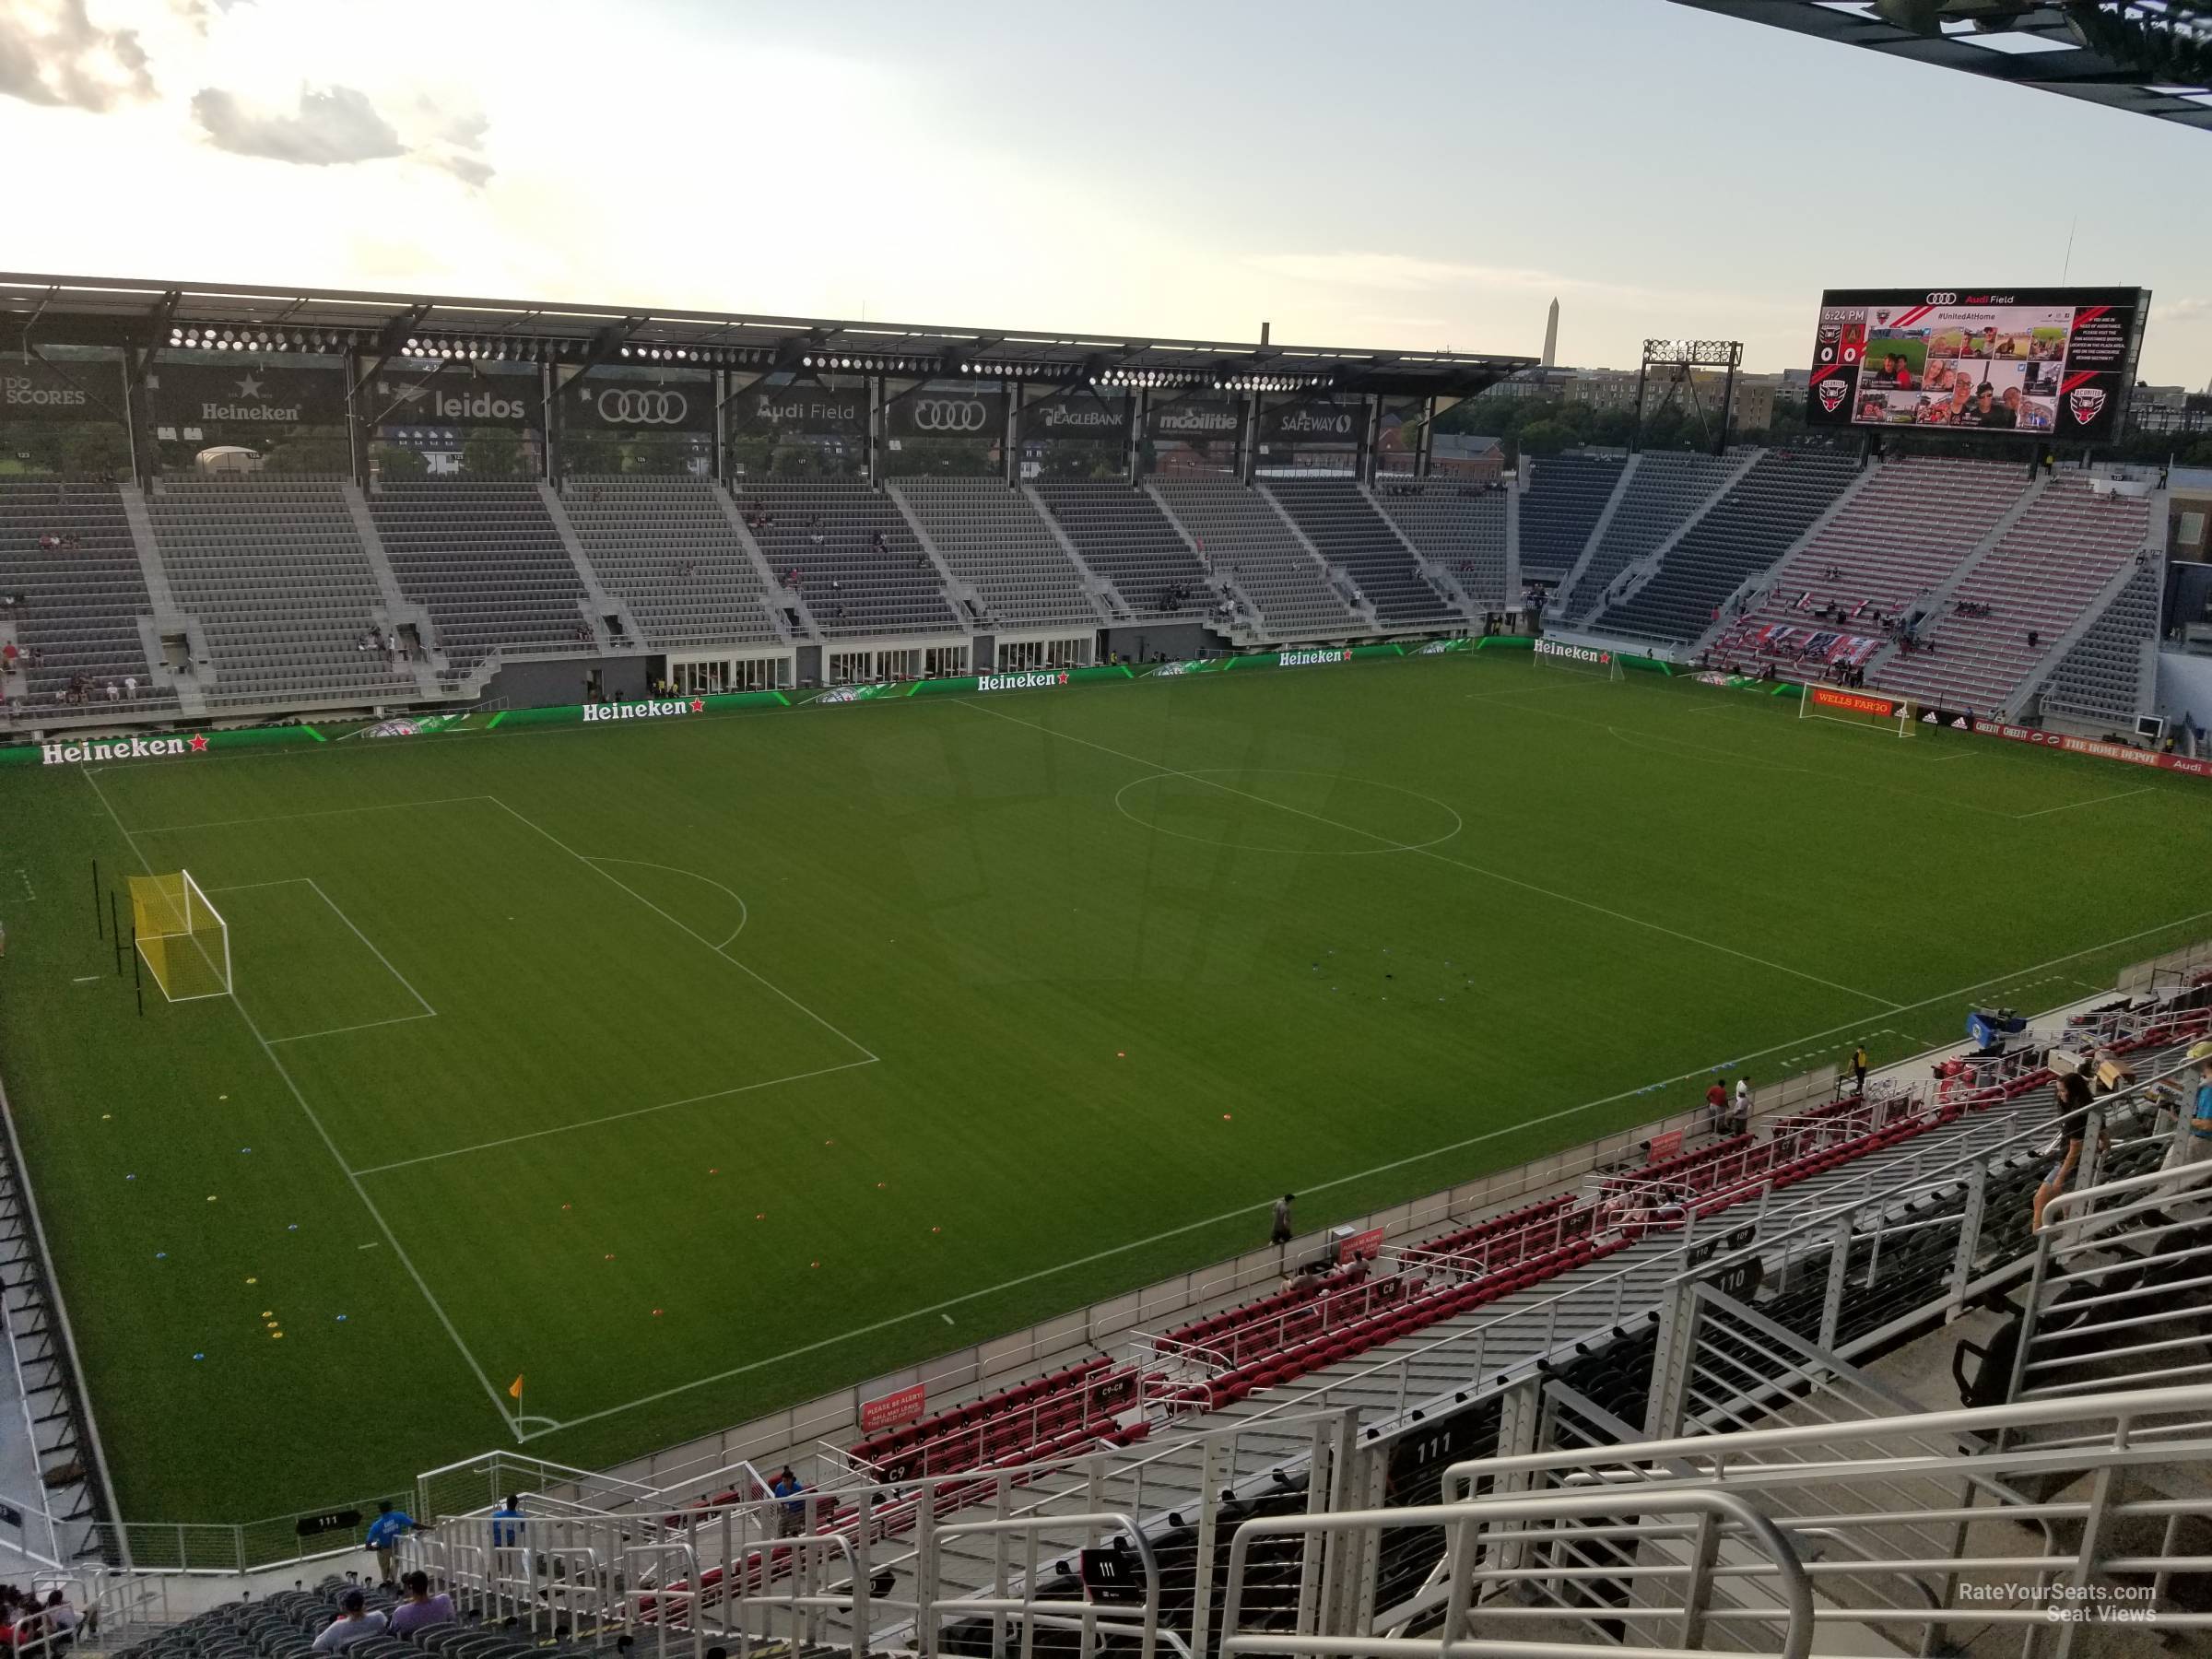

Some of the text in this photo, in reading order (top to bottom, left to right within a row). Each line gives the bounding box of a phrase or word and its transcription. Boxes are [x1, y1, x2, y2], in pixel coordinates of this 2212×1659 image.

[1965, 295, 2014, 303] Audi Field
[1824, 310, 1865, 321] 6:24 PM
[1820, 347, 1833, 361] 0
[1843, 347, 1856, 362] 0
[6, 377, 32, 390] DC
[6, 390, 87, 406] SCORES
[435, 390, 526, 418] leidos
[202, 403, 300, 421] Heineken
[757, 404, 855, 419] Audi Field
[1159, 413, 1238, 429] mobilitie
[1281, 416, 1336, 431] SAFEWAY
[1278, 648, 1342, 666] Heineken
[1534, 638, 1598, 663] Heineken
[977, 672, 1055, 691] Heineken
[1818, 692, 1888, 712] WELLS FARGO
[582, 699, 688, 722] Heineken
[42, 736, 186, 765] Heineken
[2172, 759, 2202, 772] Audi
[1736, 1230, 1748, 1241] 109
[1720, 1269, 1745, 1291] 110
[867, 1402, 890, 1417] PLEASE
[891, 1399, 900, 1408] BE
[888, 1409, 900, 1418] MAY
[900, 1403, 919, 1413] LEAVE
[1418, 1431, 1450, 1464] 111
[888, 1465, 905, 1481] C9
[318, 1515, 337, 1526] 111
[1100, 1561, 1115, 1577] 111
